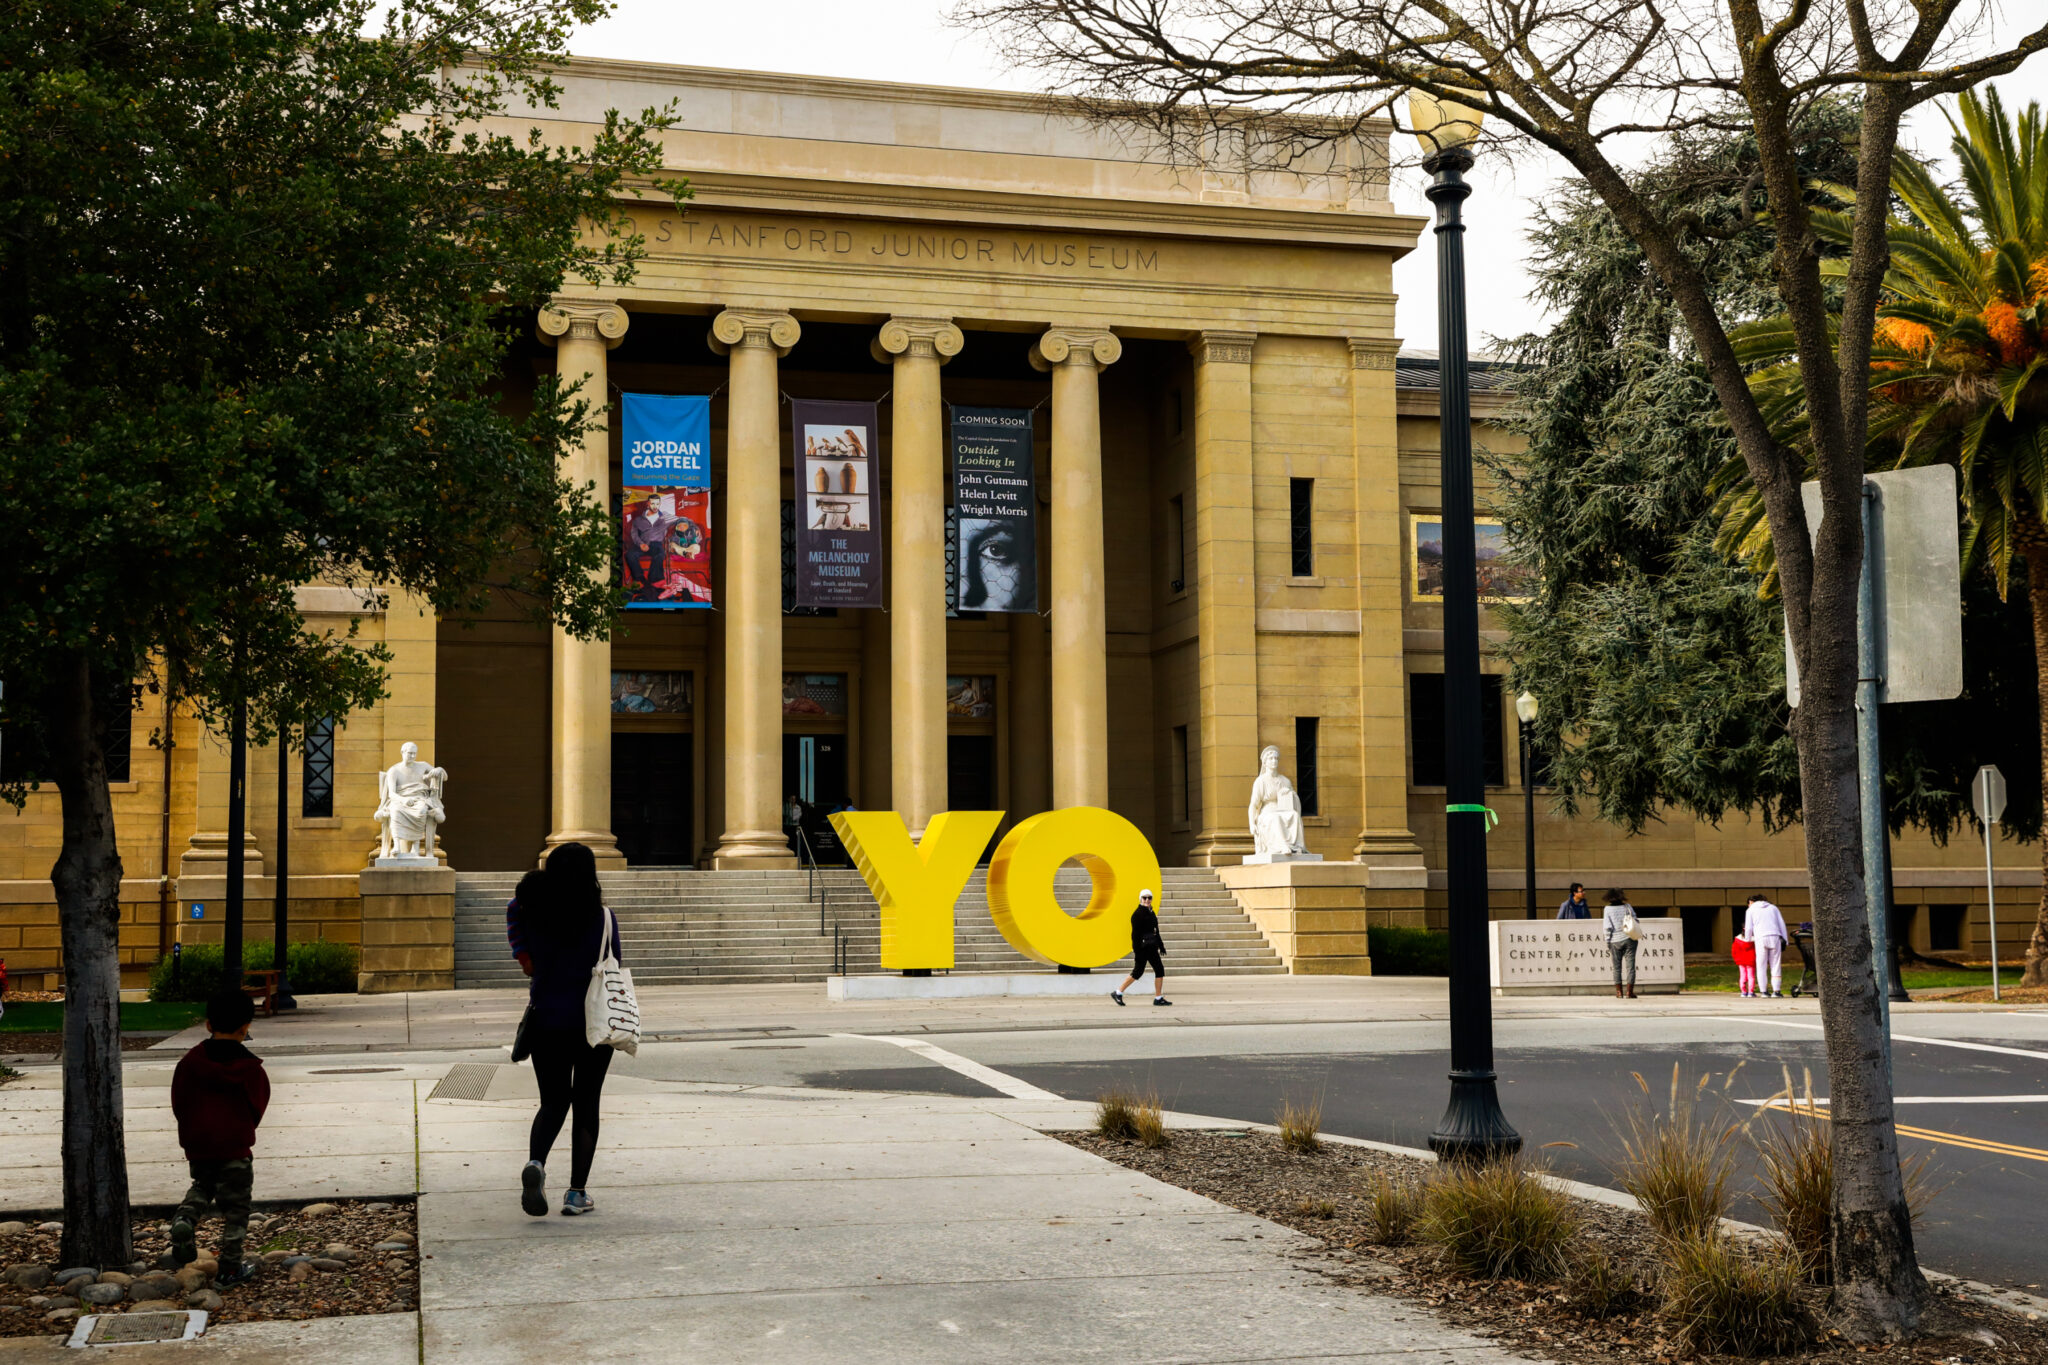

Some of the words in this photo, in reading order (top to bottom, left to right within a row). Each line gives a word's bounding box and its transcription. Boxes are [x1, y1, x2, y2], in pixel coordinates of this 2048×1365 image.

[655, 219, 853, 254] STANFORD
[871, 233, 994, 262] JUNIOR
[1012, 241, 1158, 272] MUSEUM
[959, 415, 998, 425] COMING
[999, 417, 1025, 426] SOON
[631, 440, 701, 456] JORDAN
[958, 444, 999, 455] Outside
[630, 454, 702, 470] CASTEEL
[959, 455, 1001, 469] Looking
[1004, 457, 1015, 467] In
[958, 473, 982, 486] John
[984, 474, 1028, 487] Gutmann
[959, 488, 988, 499] Helen
[990, 490, 1018, 501] Levitt
[959, 503, 993, 517] Wright
[995, 505, 1028, 517] Morris
[831, 538, 848, 550] THE
[808, 551, 870, 564] MELANCHOLY
[818, 564, 861, 577] MUSEUM
[826, 805, 1162, 968] YO
[1510, 934, 1537, 943] IRIS
[1555, 933, 1561, 942] B
[1568, 933, 1606, 942] GERA
[1641, 932, 1673, 941] NTOR
[1509, 949, 1562, 960] CENTER
[1567, 950, 1584, 961] for
[1642, 947, 1674, 957] ARTS
